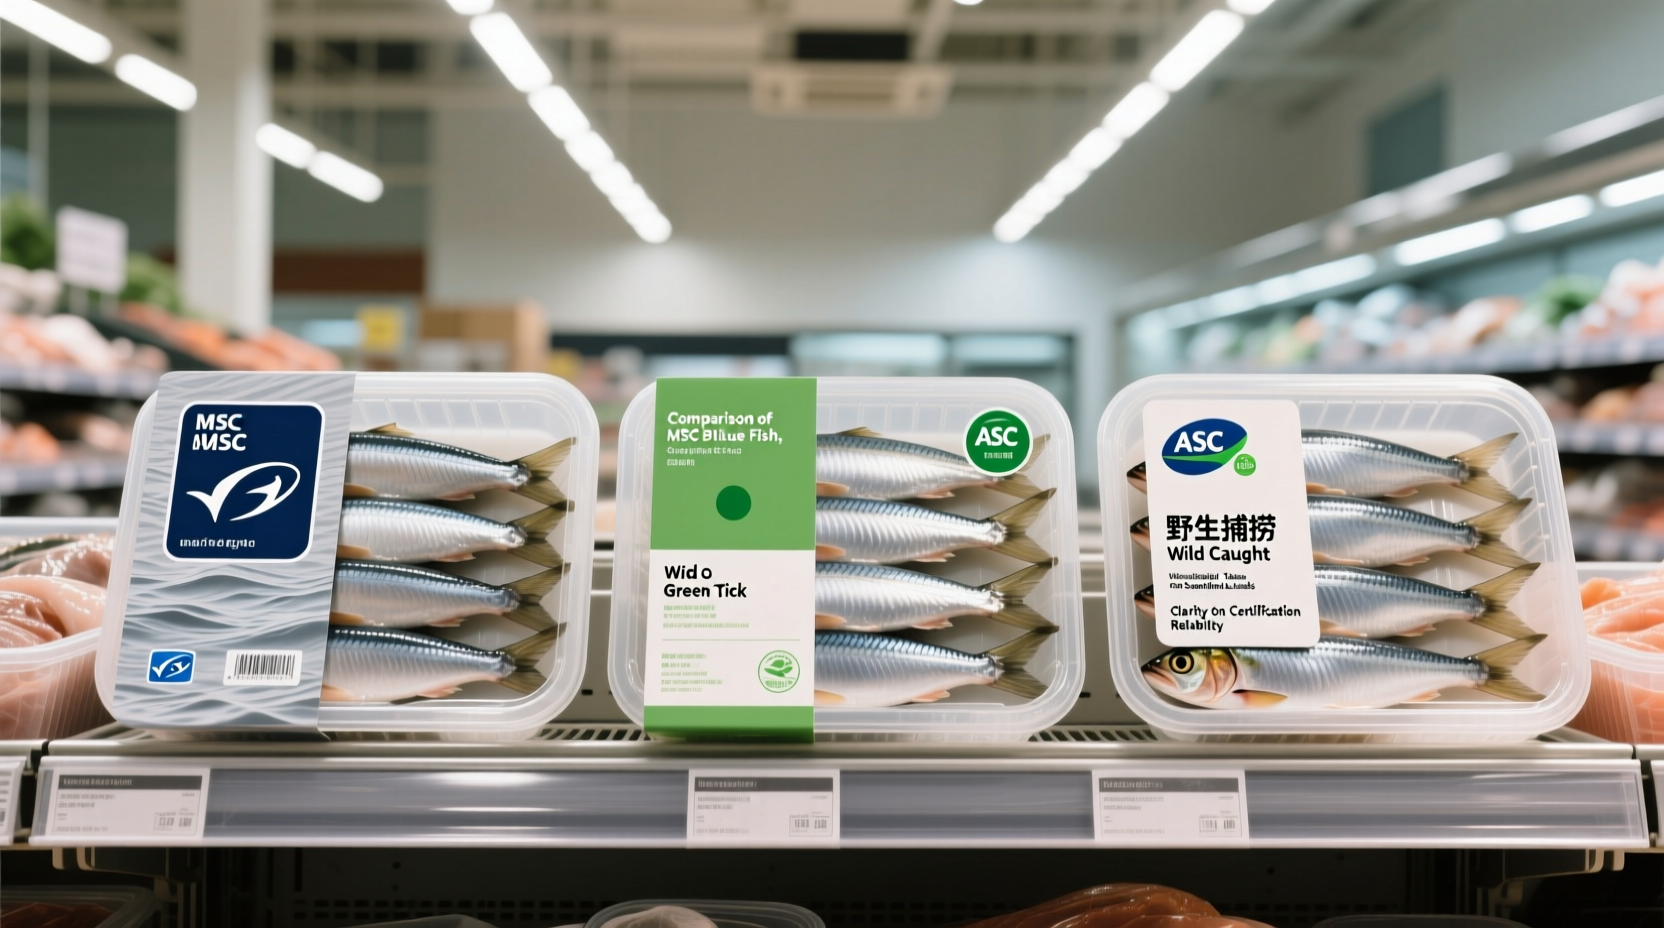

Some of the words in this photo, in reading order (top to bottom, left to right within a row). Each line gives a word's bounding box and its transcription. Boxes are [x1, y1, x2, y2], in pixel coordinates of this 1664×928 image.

[195, 413, 243, 431] MSC
[667, 411, 754, 430] Comparison
[757, 411, 774, 425] of
[667, 428, 700, 442] MSC
[974, 426, 1019, 447] ASC
[1173, 431, 1224, 453] ASC
[1166, 513, 1277, 543] 野生捕捞
[1167, 545, 1205, 561] Wild
[1209, 545, 1271, 564] Caught
[664, 564, 698, 579] Wid
[663, 584, 711, 598] Green
[713, 582, 748, 598] Tick
